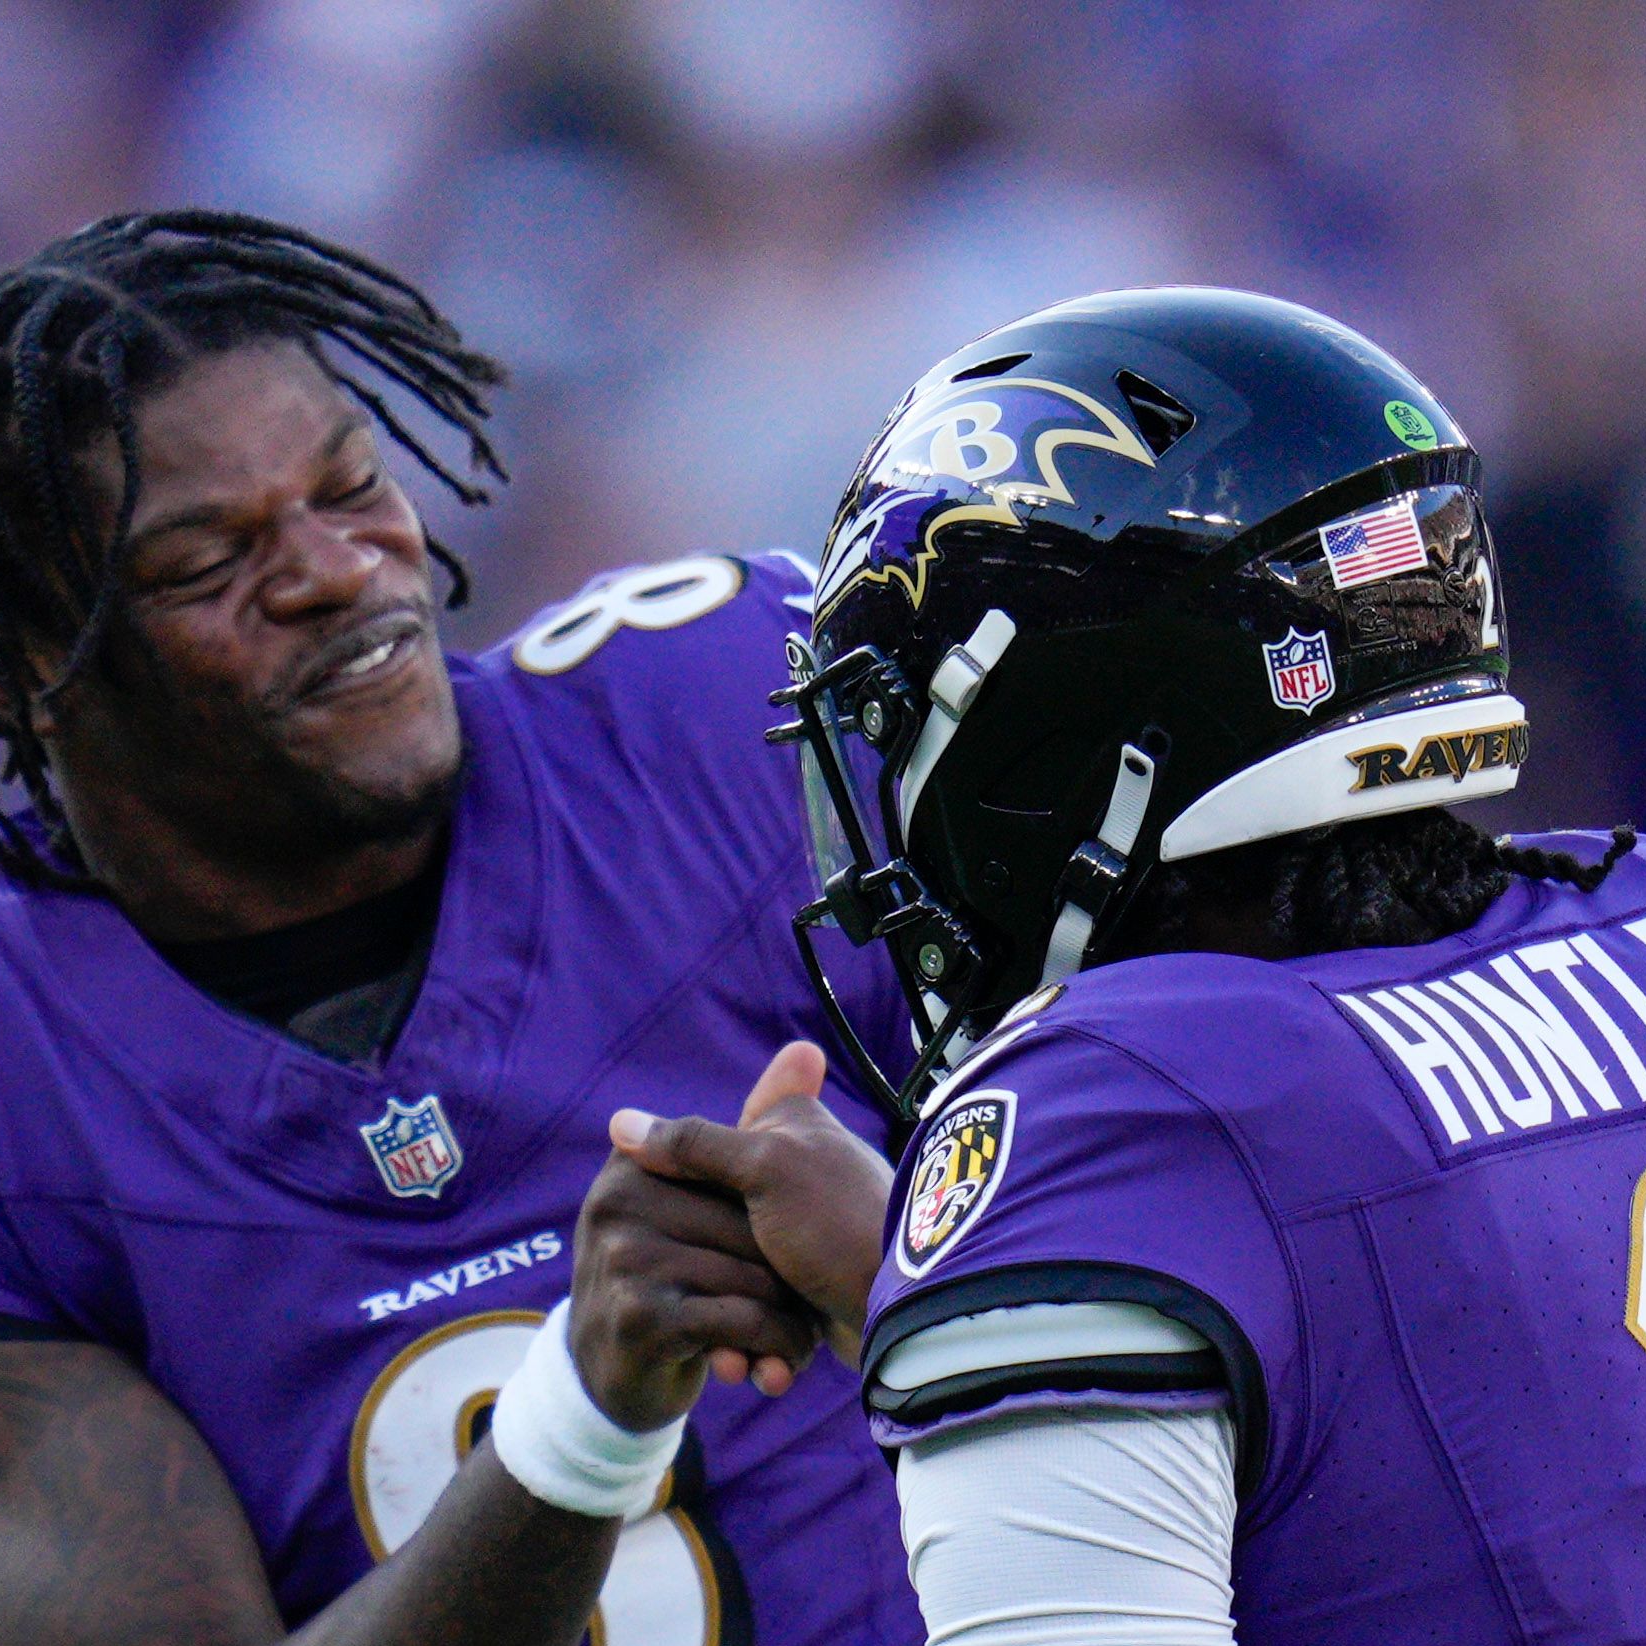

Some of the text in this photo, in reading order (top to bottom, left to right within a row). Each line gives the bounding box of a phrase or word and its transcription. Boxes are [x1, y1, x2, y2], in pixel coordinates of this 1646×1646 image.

[897, 400, 1019, 482] B
[513, 556, 744, 676] 8
[1278, 663, 1327, 700] NFL
[1344, 719, 1530, 795] RAVENS
[387, 1139, 449, 1187] NFL
[922, 1105, 997, 1159] RAVENS
[358, 1232, 563, 1321] RAVENS
